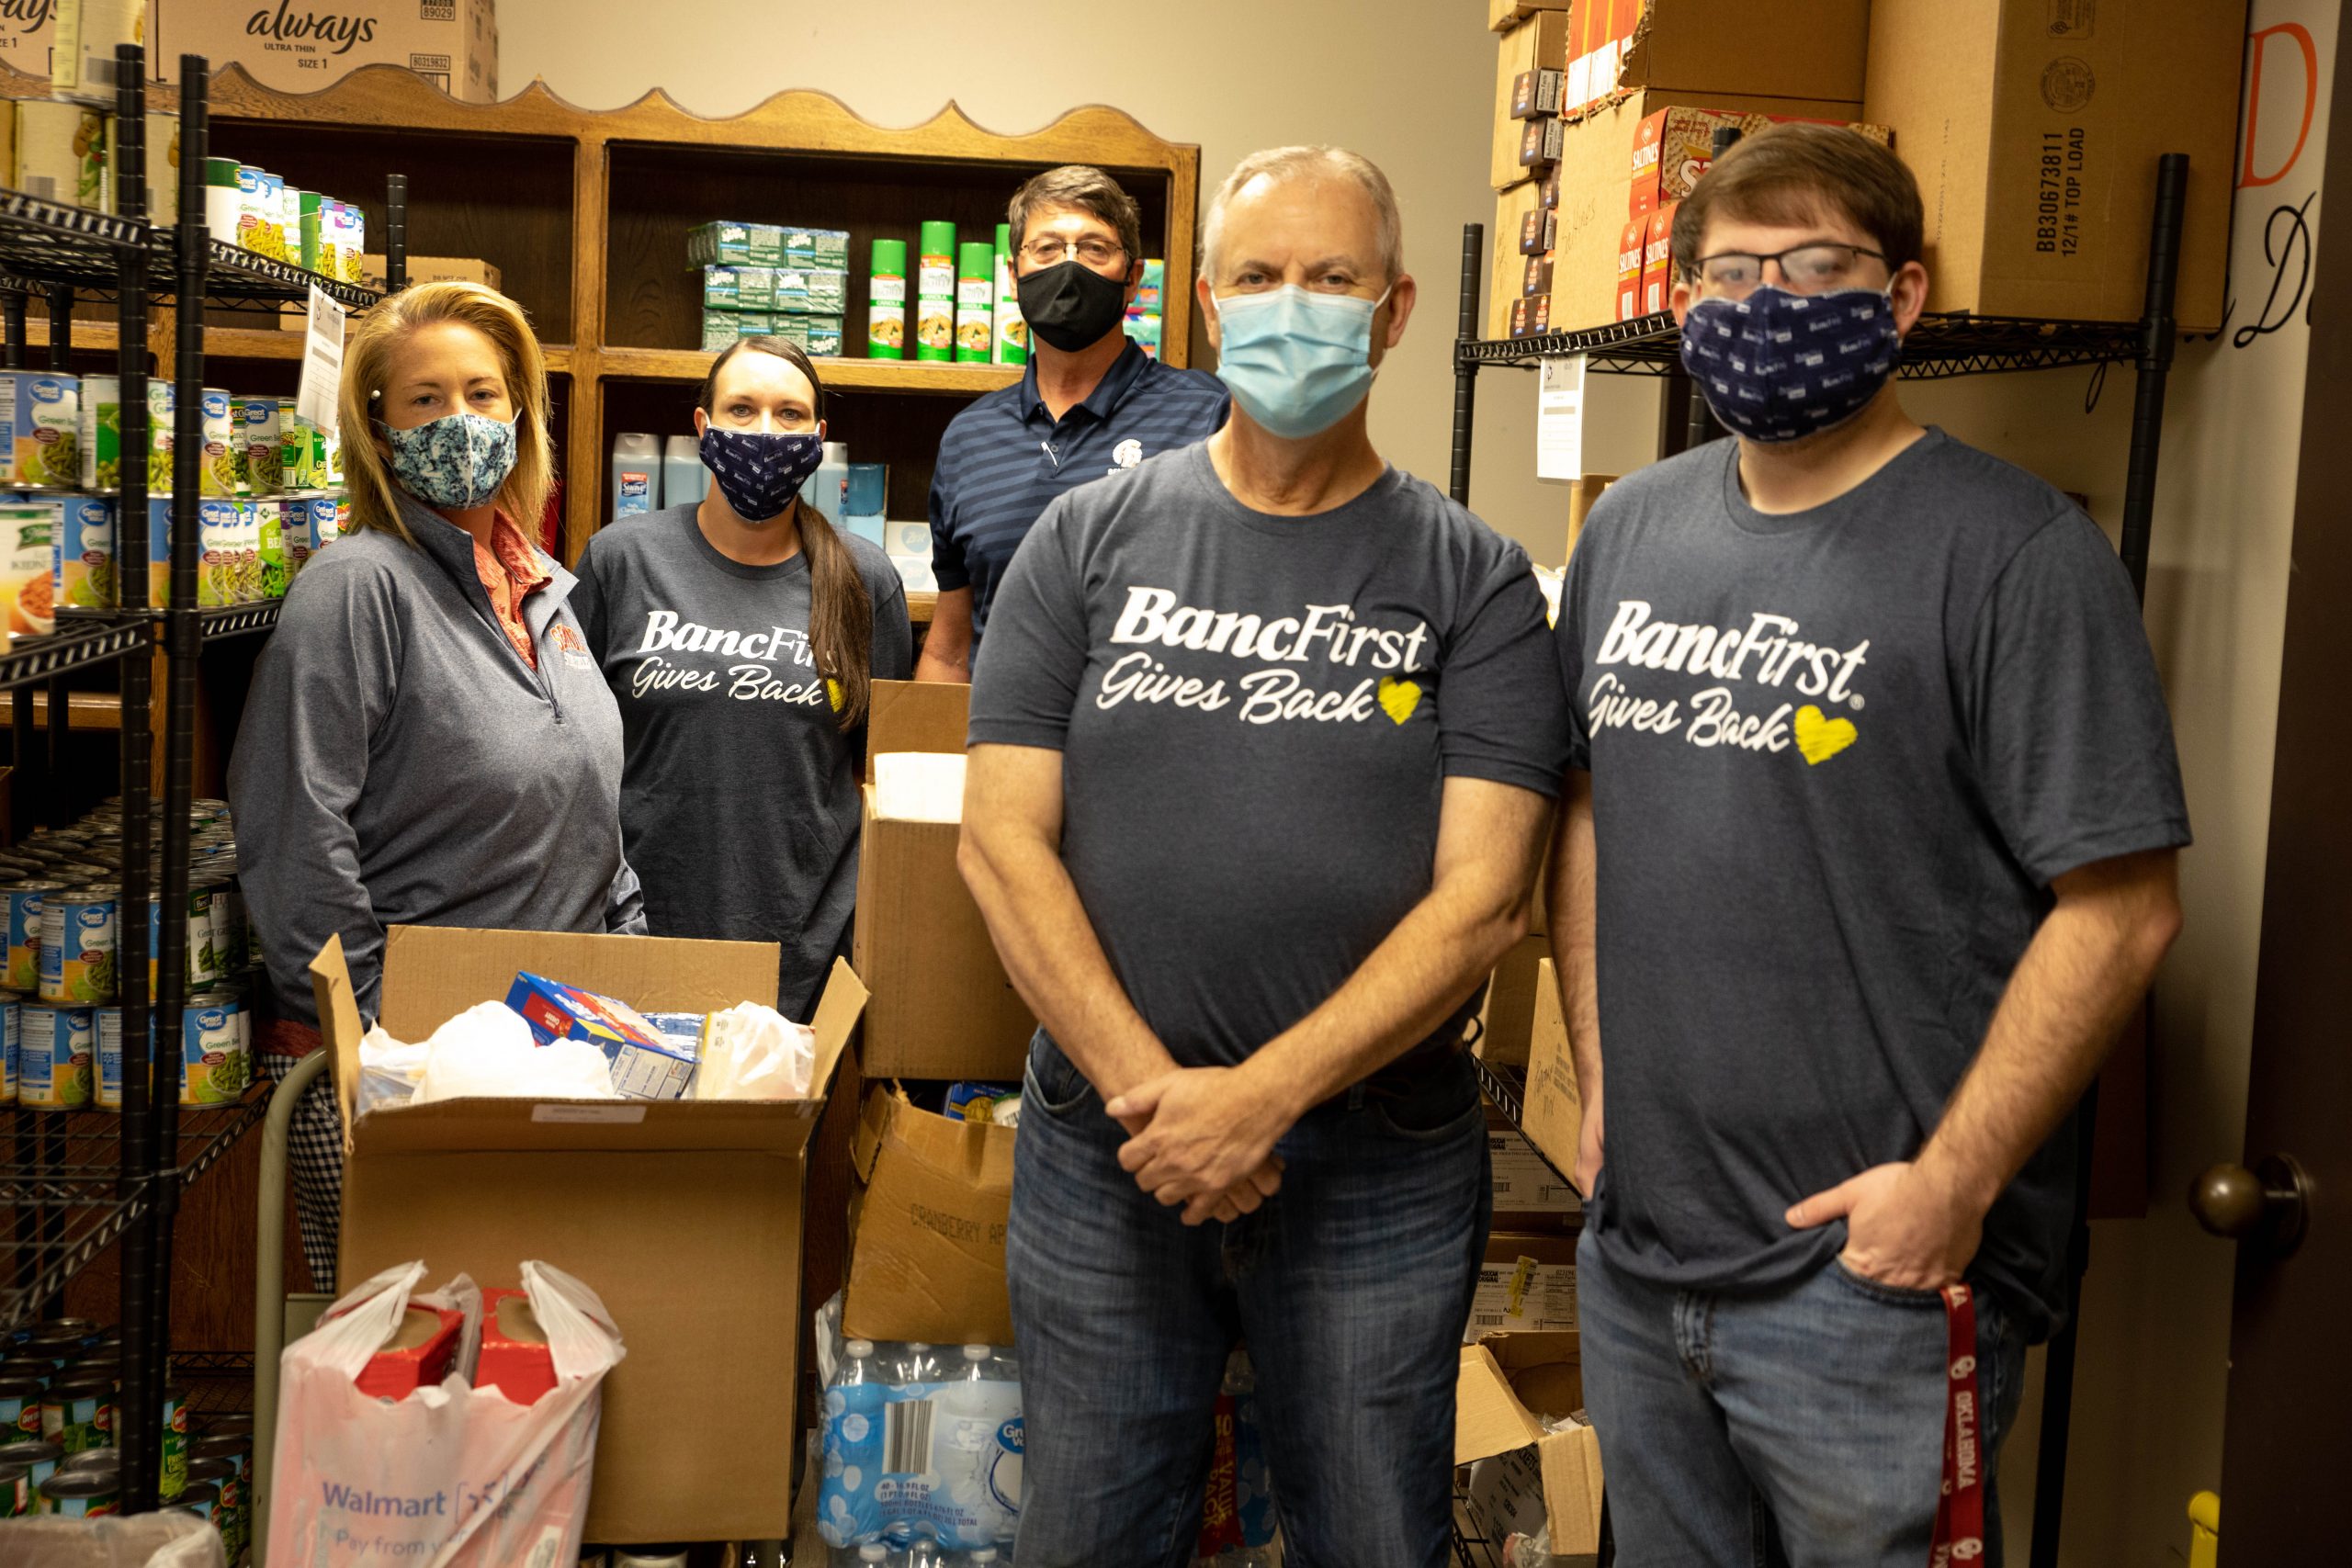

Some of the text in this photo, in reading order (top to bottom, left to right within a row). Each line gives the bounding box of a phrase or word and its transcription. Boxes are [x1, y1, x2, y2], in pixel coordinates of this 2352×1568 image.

[246, 0, 378, 55] always
[423, 6, 453, 19] 89029
[264, 42, 316, 53] ULTRA THIN
[298, 58, 328, 70] SIZE 1
[1633, 141, 1659, 171] SALTINES
[2036, 132, 2063, 254] BB30673811
[2062, 128, 2085, 257] 12/1# TOP LOAD
[1619, 247, 1641, 274] SALTINES
[1646, 237, 1669, 265] SALTINES
[1110, 586, 1427, 672] BancFirst
[1596, 600, 1871, 704] BancFirst
[632, 656, 822, 705] Gives Back
[1096, 651, 1374, 725] Gives Back
[1589, 672, 1792, 753] Gives Back
[206, 1039, 230, 1050] Green
[910, 1203, 981, 1244] CRANBERRY
[1954, 1391, 1977, 1491] OKLAHOMA
[322, 1481, 447, 1517] Walmart
[335, 1528, 368, 1558] Pay
[374, 1536, 424, 1555] from
